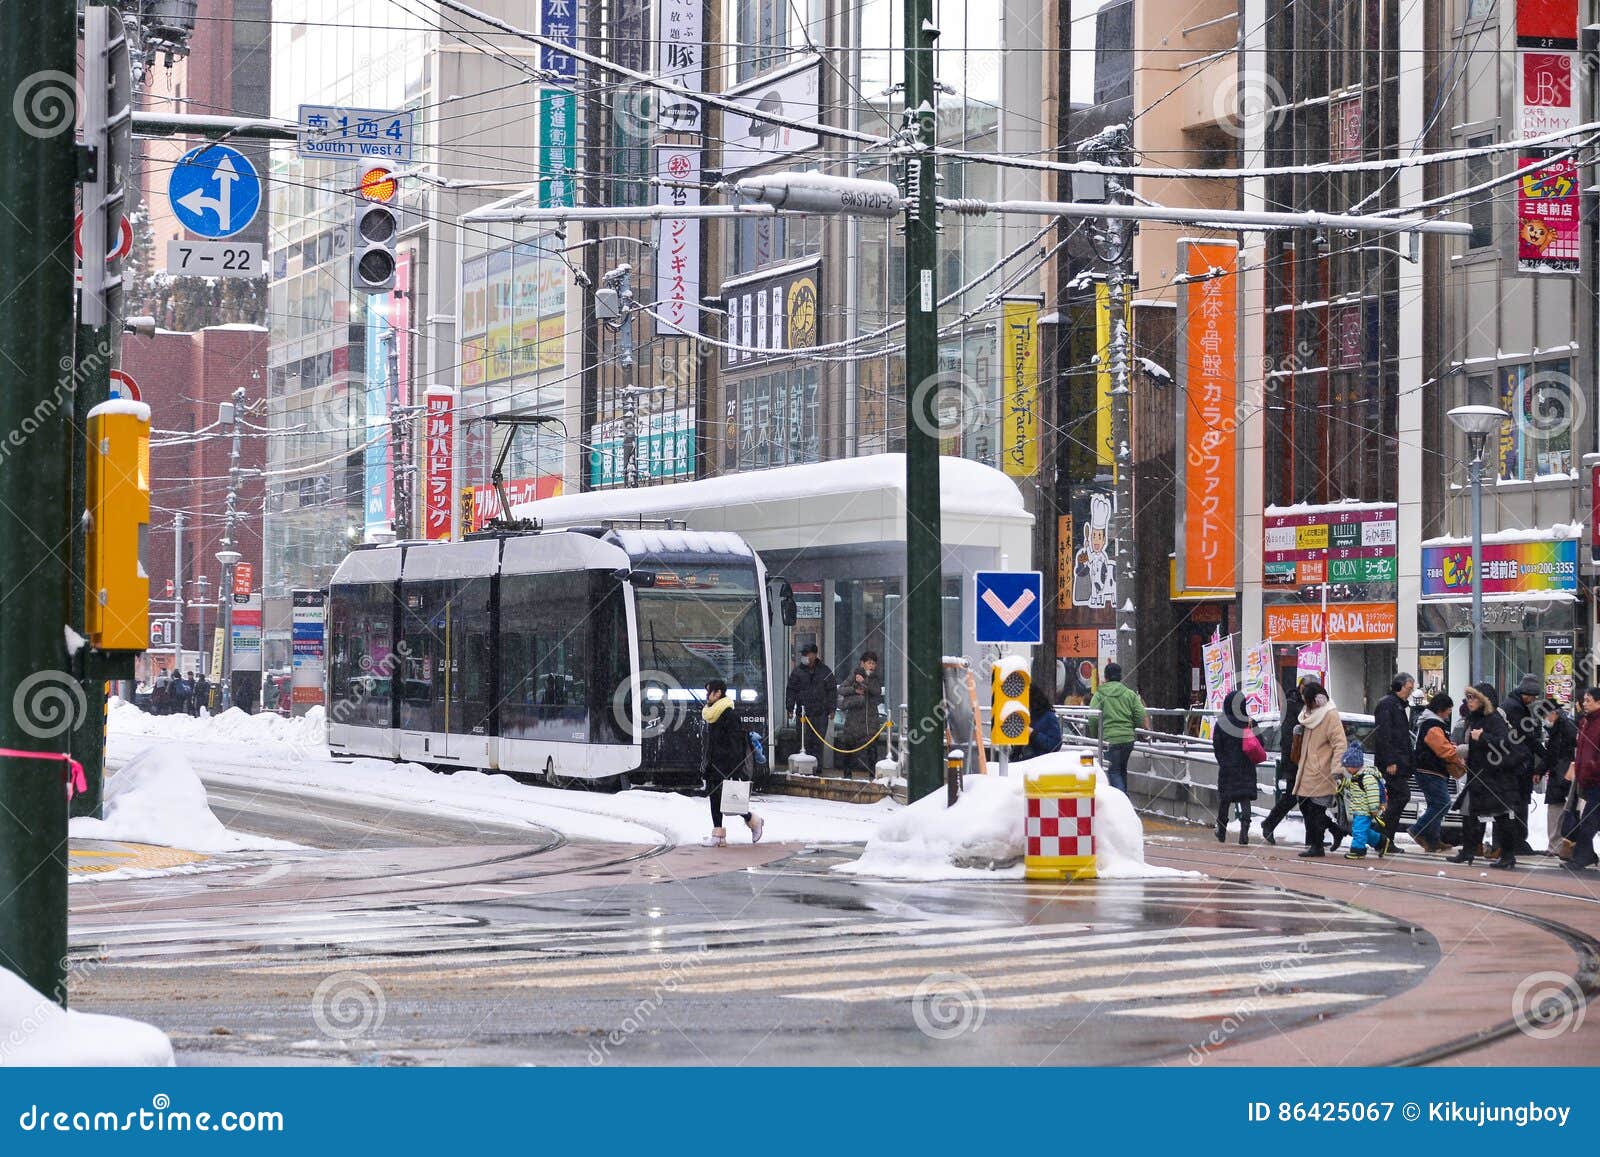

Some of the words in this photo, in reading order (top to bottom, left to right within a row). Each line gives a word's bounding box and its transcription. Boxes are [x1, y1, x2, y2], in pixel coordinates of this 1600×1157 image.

[1541, 39, 1553, 48] 2F
[430, 400, 450, 528] ツルハドラッグ
